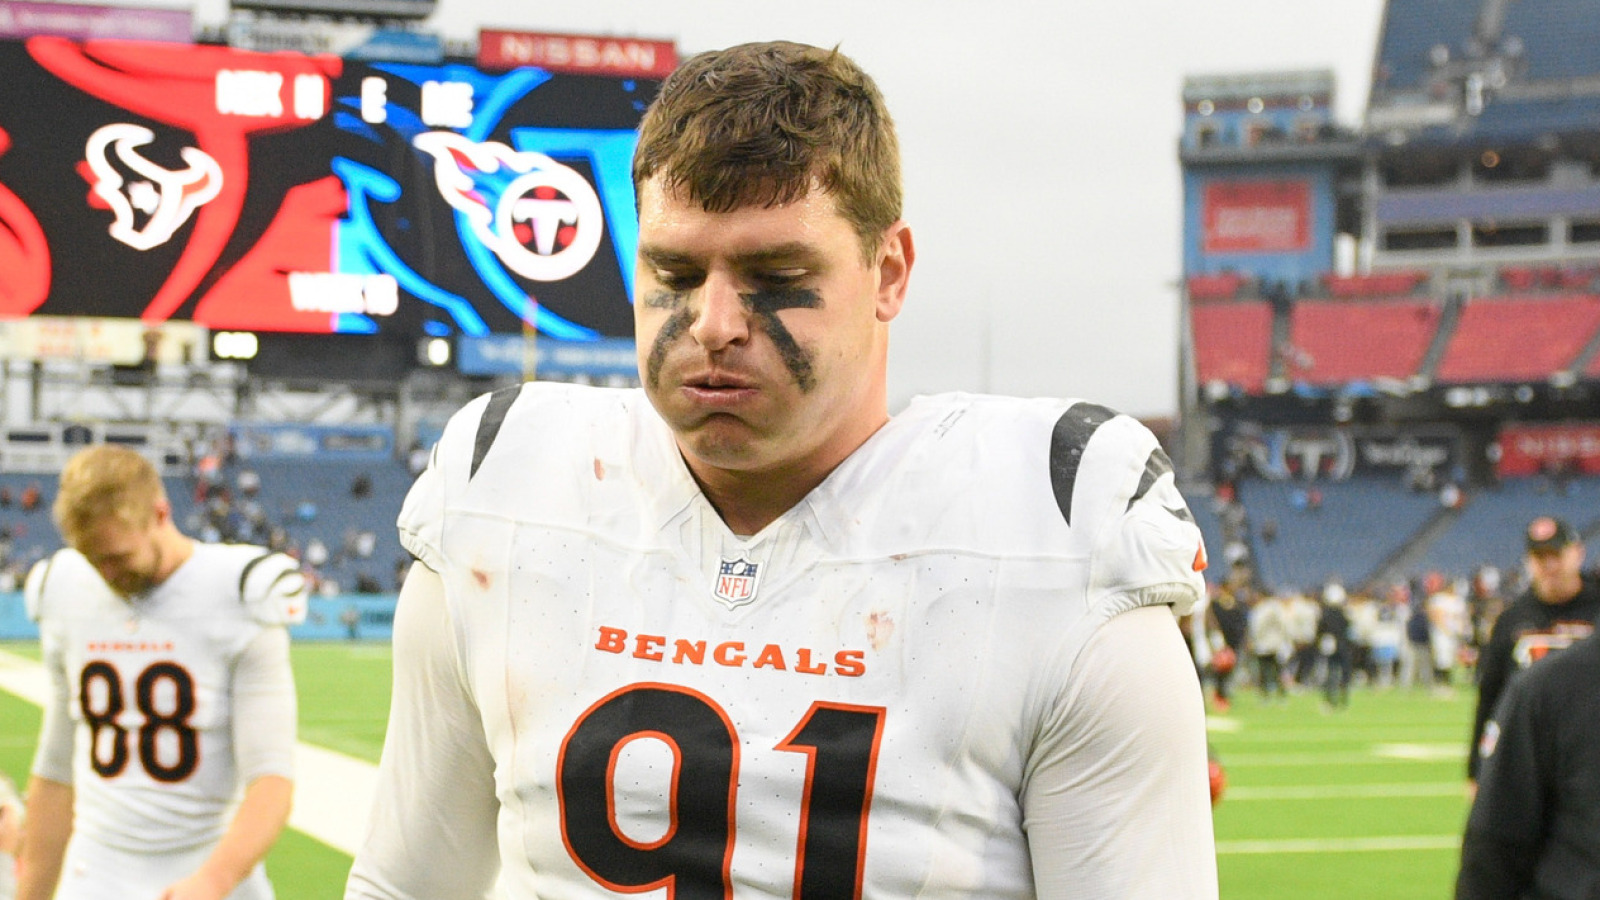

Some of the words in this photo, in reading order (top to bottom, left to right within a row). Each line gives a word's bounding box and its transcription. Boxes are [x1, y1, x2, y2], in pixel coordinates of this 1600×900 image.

[500, 34, 656, 70] NISSAN
[719, 576, 749, 598] NFL
[595, 625, 867, 678] BENGALS
[79, 659, 200, 784] 88
[556, 681, 887, 900] 91
